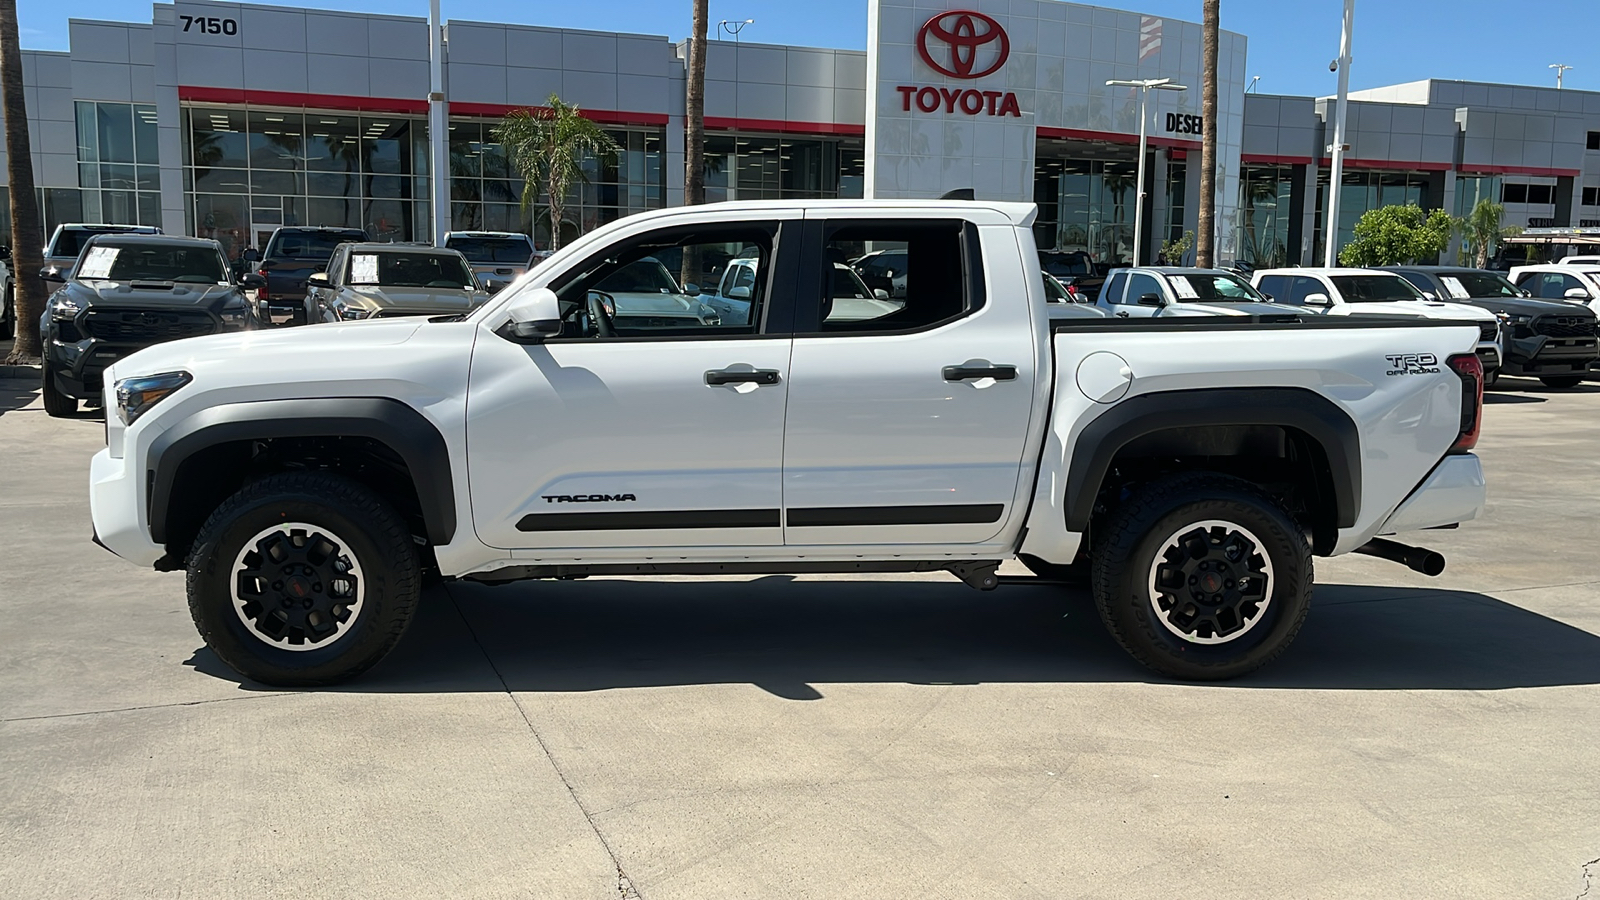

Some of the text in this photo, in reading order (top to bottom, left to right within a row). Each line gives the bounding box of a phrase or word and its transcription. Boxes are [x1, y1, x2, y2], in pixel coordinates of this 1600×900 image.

[180, 15, 237, 35] 7150
[896, 86, 1021, 117] TOYOTA
[1385, 353, 1437, 370] TRD
[541, 494, 636, 503] TACOMA
